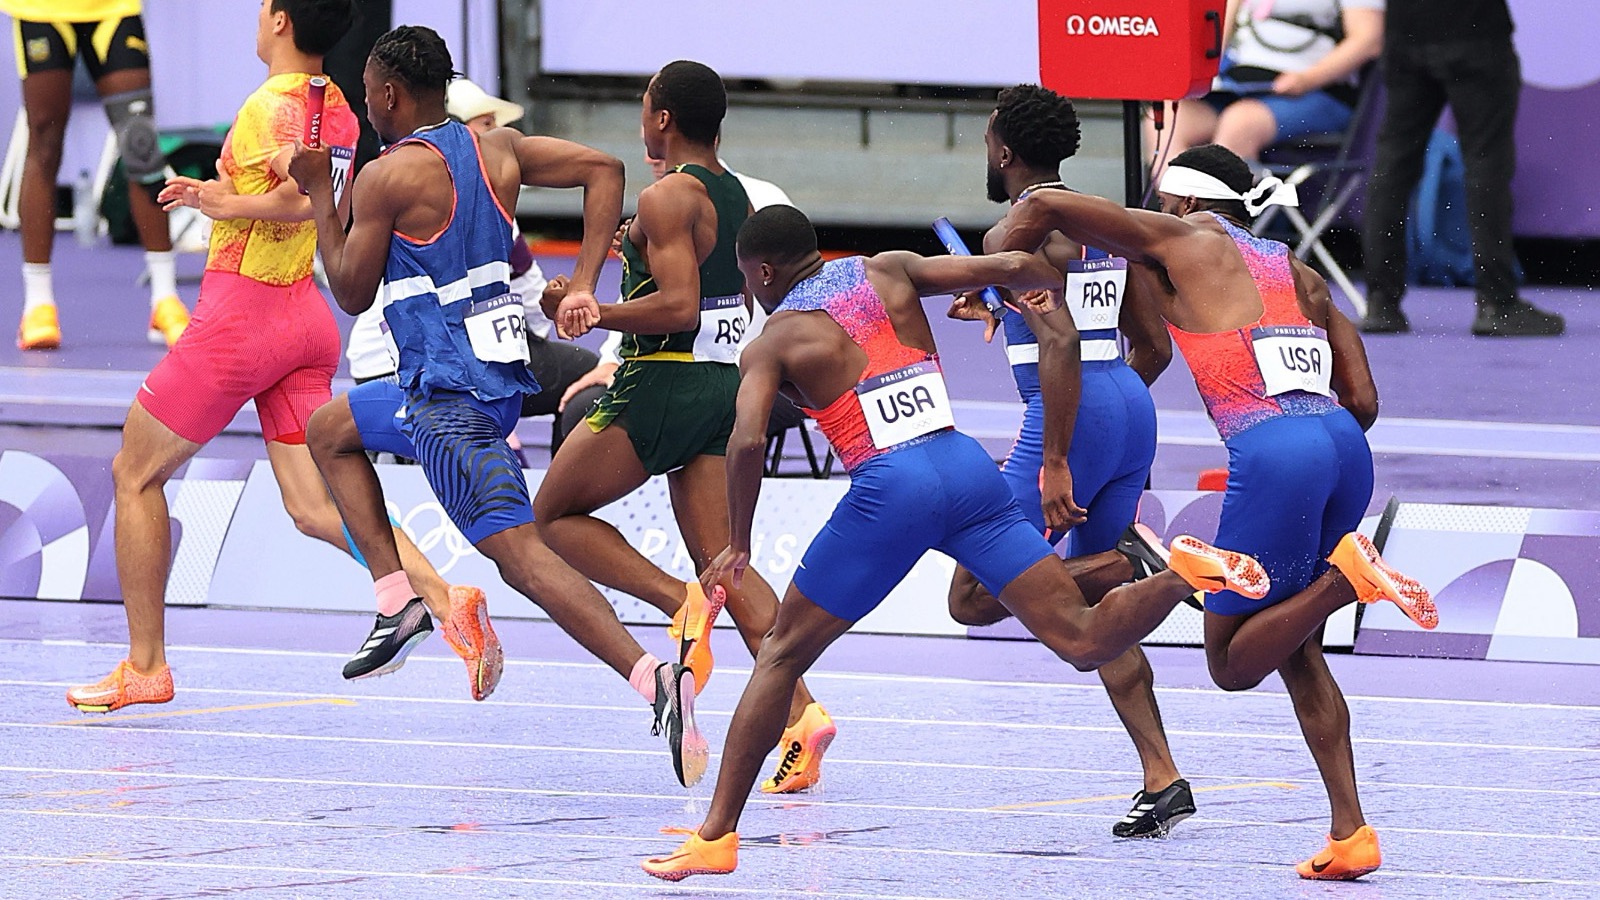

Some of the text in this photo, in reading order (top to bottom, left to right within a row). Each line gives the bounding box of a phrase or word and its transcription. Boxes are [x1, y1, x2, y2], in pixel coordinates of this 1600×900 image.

[1088, 15, 1159, 36] OMEGA
[1082, 280, 1117, 308] FRA
[1274, 327, 1297, 335] PARIS
[1278, 346, 1321, 375] USA
[880, 366, 924, 384] PARIS 2024
[876, 385, 936, 424] USA
[773, 740, 803, 787] NITRO
